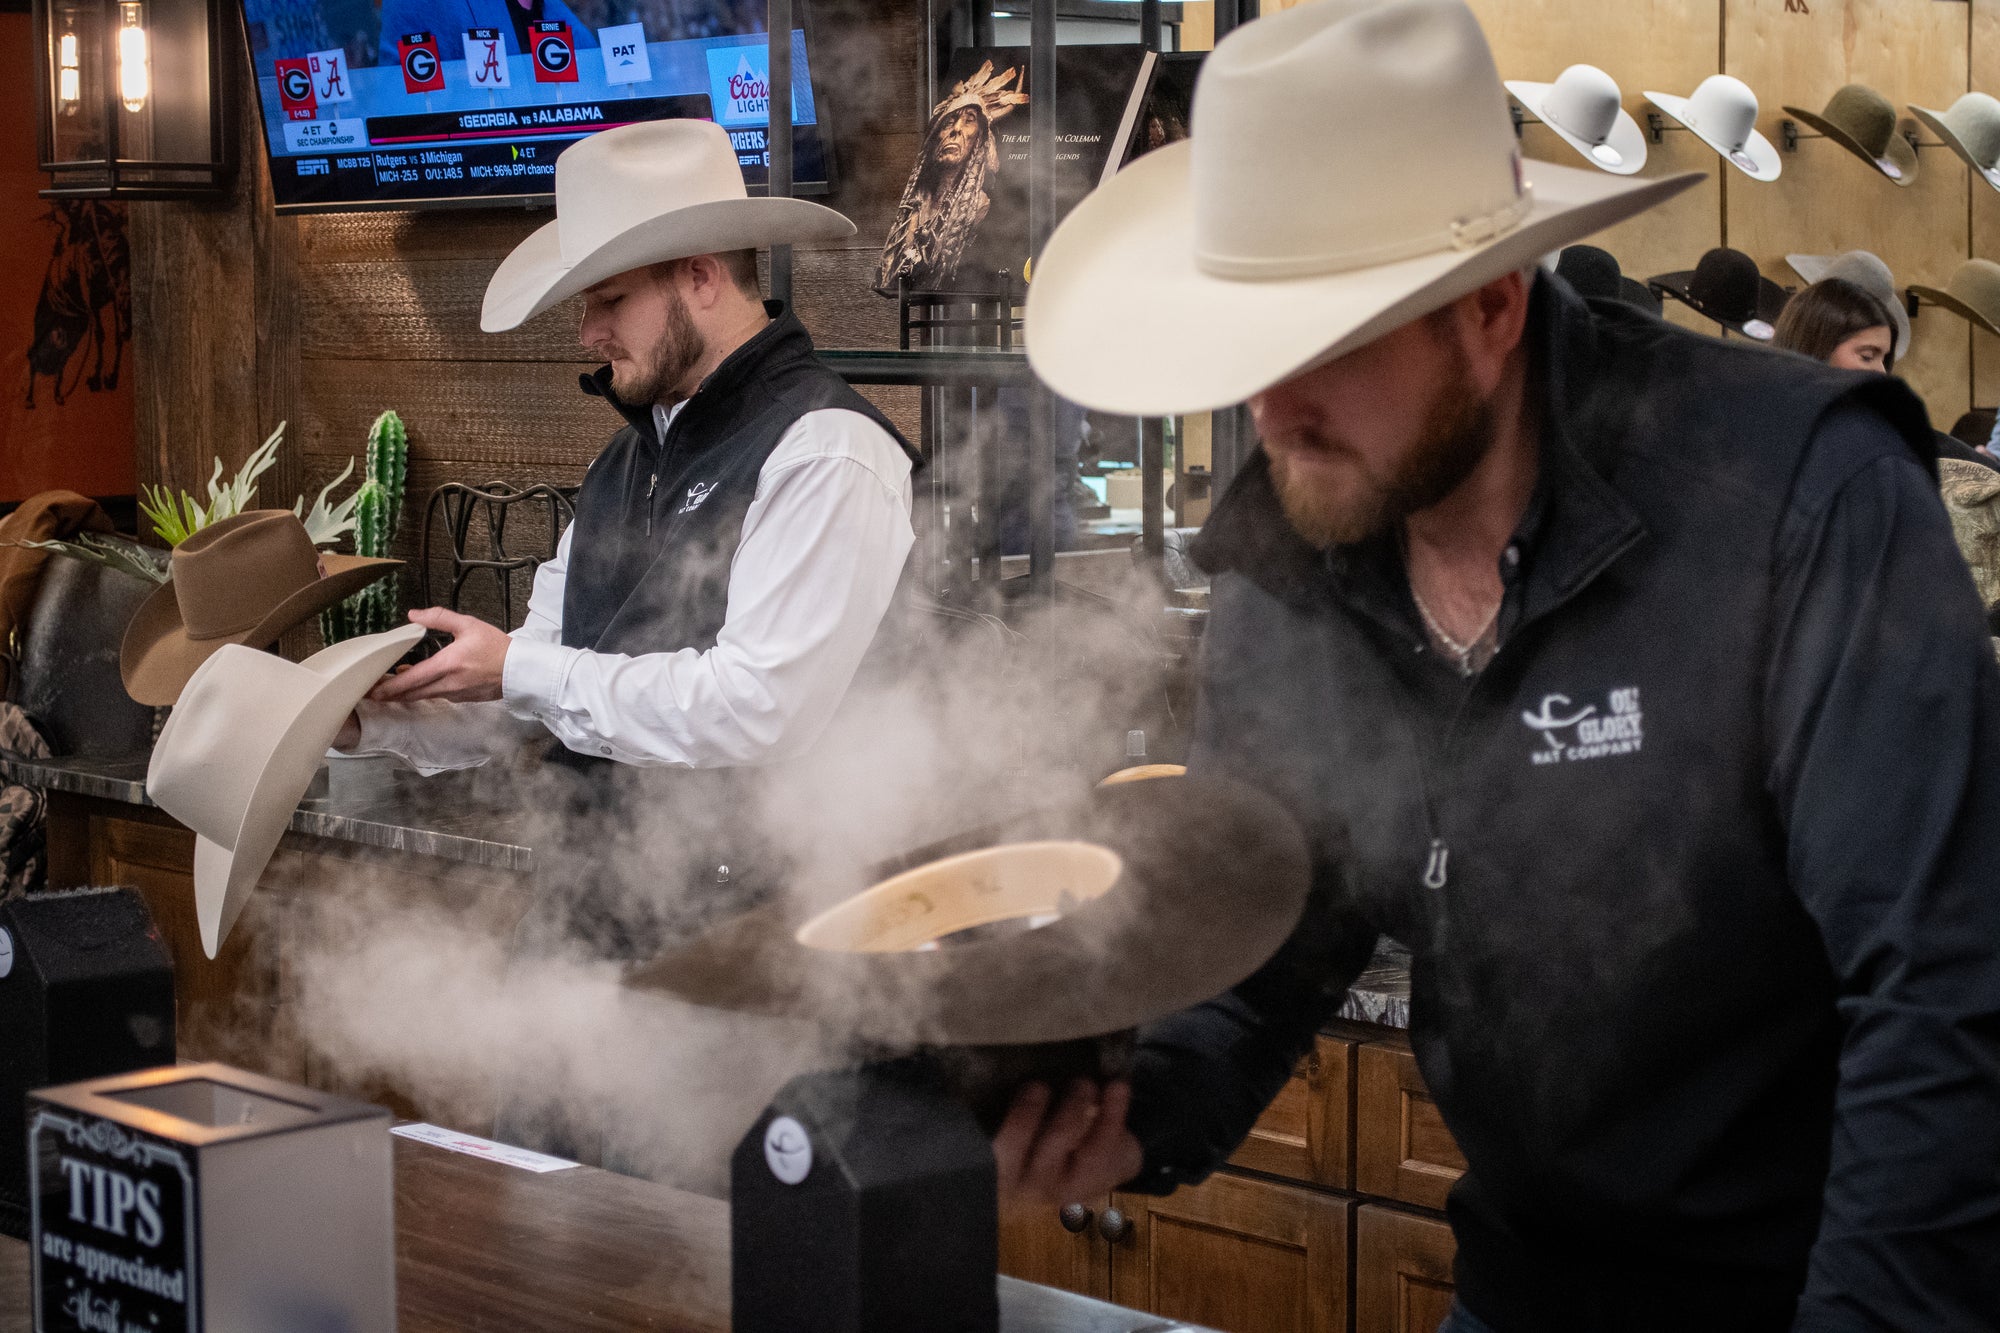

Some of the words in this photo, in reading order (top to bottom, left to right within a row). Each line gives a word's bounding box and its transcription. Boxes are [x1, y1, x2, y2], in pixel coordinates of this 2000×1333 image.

[476, 30, 492, 38] NICK
[541, 23, 560, 32] ERNIE
[410, 34, 423, 44] DES
[537, 36, 571, 73] G
[612, 44, 636, 58] PAT
[405, 47, 437, 83] G
[475, 41, 502, 83] A
[282, 68, 312, 102] G
[321, 57, 345, 99] A
[728, 74, 769, 100] Coor
[464, 112, 518, 128] GEORGIA
[539, 106, 603, 123] ALABAMA
[303, 126, 309, 135] 4
[311, 125, 321, 135] ET
[297, 138, 309, 147] SEC
[310, 136, 355, 146] CHAMPIONSHIP
[729, 131, 765, 150] RGERS
[376, 154, 407, 168] Rutgers
[409, 155, 418, 165] vs
[420, 153, 426, 164] 3
[426, 151, 463, 166] Michigan
[520, 148, 526, 158] 4
[527, 147, 536, 158] ET
[739, 155, 760, 165] ESPN
[1055, 153, 1080, 161] EGENDS
[296, 158, 330, 176] ESPN
[359, 157, 371, 168] T25
[379, 170, 399, 182] MICH
[470, 165, 494, 178] MICH:
[494, 164, 513, 177] 96%
[513, 163, 527, 175] BPI
[528, 163, 555, 175] chance
[61, 1157, 164, 1247] TIPS
[43, 1232, 72, 1262] are
[76, 1243, 184, 1302] appreciated
